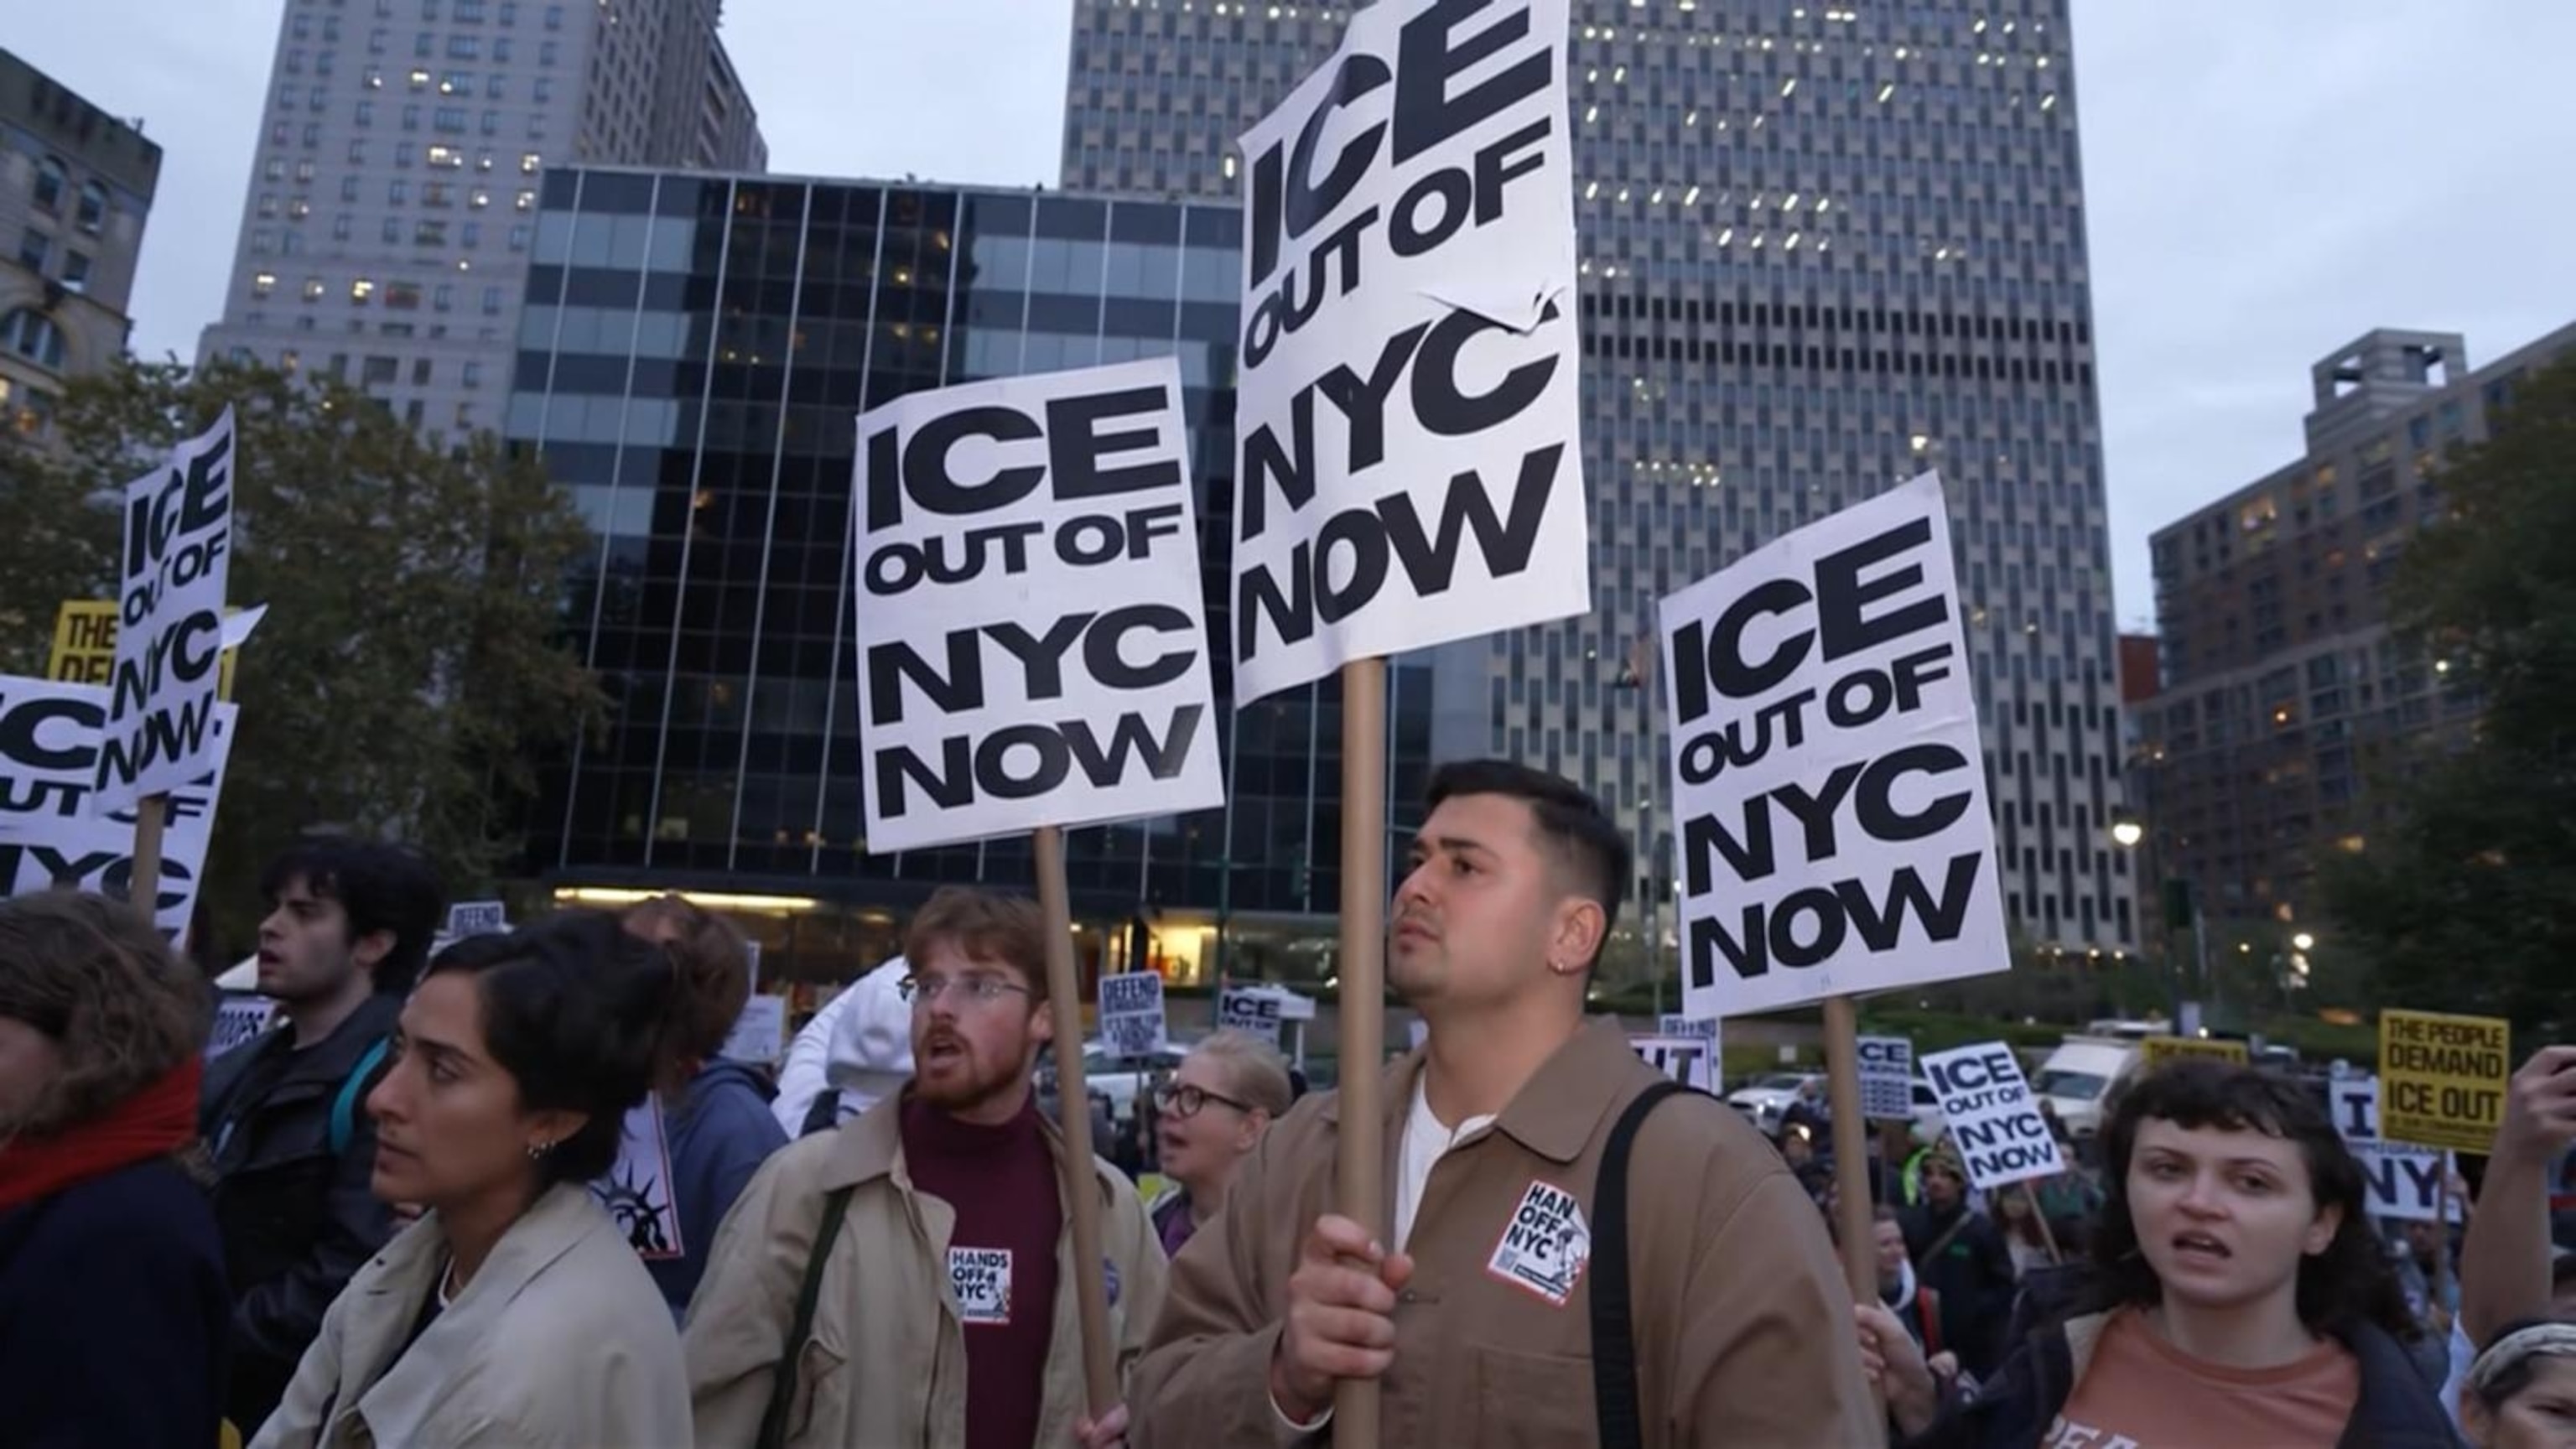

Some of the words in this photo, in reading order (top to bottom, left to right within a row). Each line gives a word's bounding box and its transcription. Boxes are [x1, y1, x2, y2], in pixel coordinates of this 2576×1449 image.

[1251, 0, 1552, 291] ICE
[1244, 205, 1379, 369] OUT
[1389, 115, 1551, 257] OF
[867, 385, 1181, 533] ICE
[1241, 300, 1560, 543] NYC
[128, 431, 230, 579] ICE
[172, 528, 227, 587] OF
[865, 521, 1044, 595] OUT
[1054, 504, 1182, 566] OF
[1239, 442, 1566, 666] NOW
[1673, 516, 1949, 725] ICE
[112, 609, 218, 720] NYC
[867, 604, 1197, 726] NYC
[1679, 688, 1816, 785] OUT
[1826, 642, 1953, 728] OF
[875, 703, 1204, 819] NOW
[1684, 743, 1972, 898] NYC
[1689, 850, 1982, 989] NOW
[1223, 995, 1280, 1019] ICE
[2388, 1017, 2424, 1041] THE
[2428, 1021, 2505, 1049] PEOPLE
[1859, 1042, 1909, 1063] CE
[1929, 1052, 2019, 1095] ICE
[2388, 1042, 2504, 1080] DEMAND
[1945, 1093, 1993, 1115] OUT
[1999, 1086, 2027, 1104] OF
[1955, 1113, 2044, 1151] NYC
[2388, 1079, 2435, 1116] ICE
[2441, 1086, 2502, 1123] OUT
[1970, 1142, 2054, 1178] NOW
[1506, 1223, 1553, 1259] NYC
[1518, 1206, 1561, 1234] OFF
[953, 1251, 1008, 1268] HANDS
[953, 1267, 987, 1281] OFF
